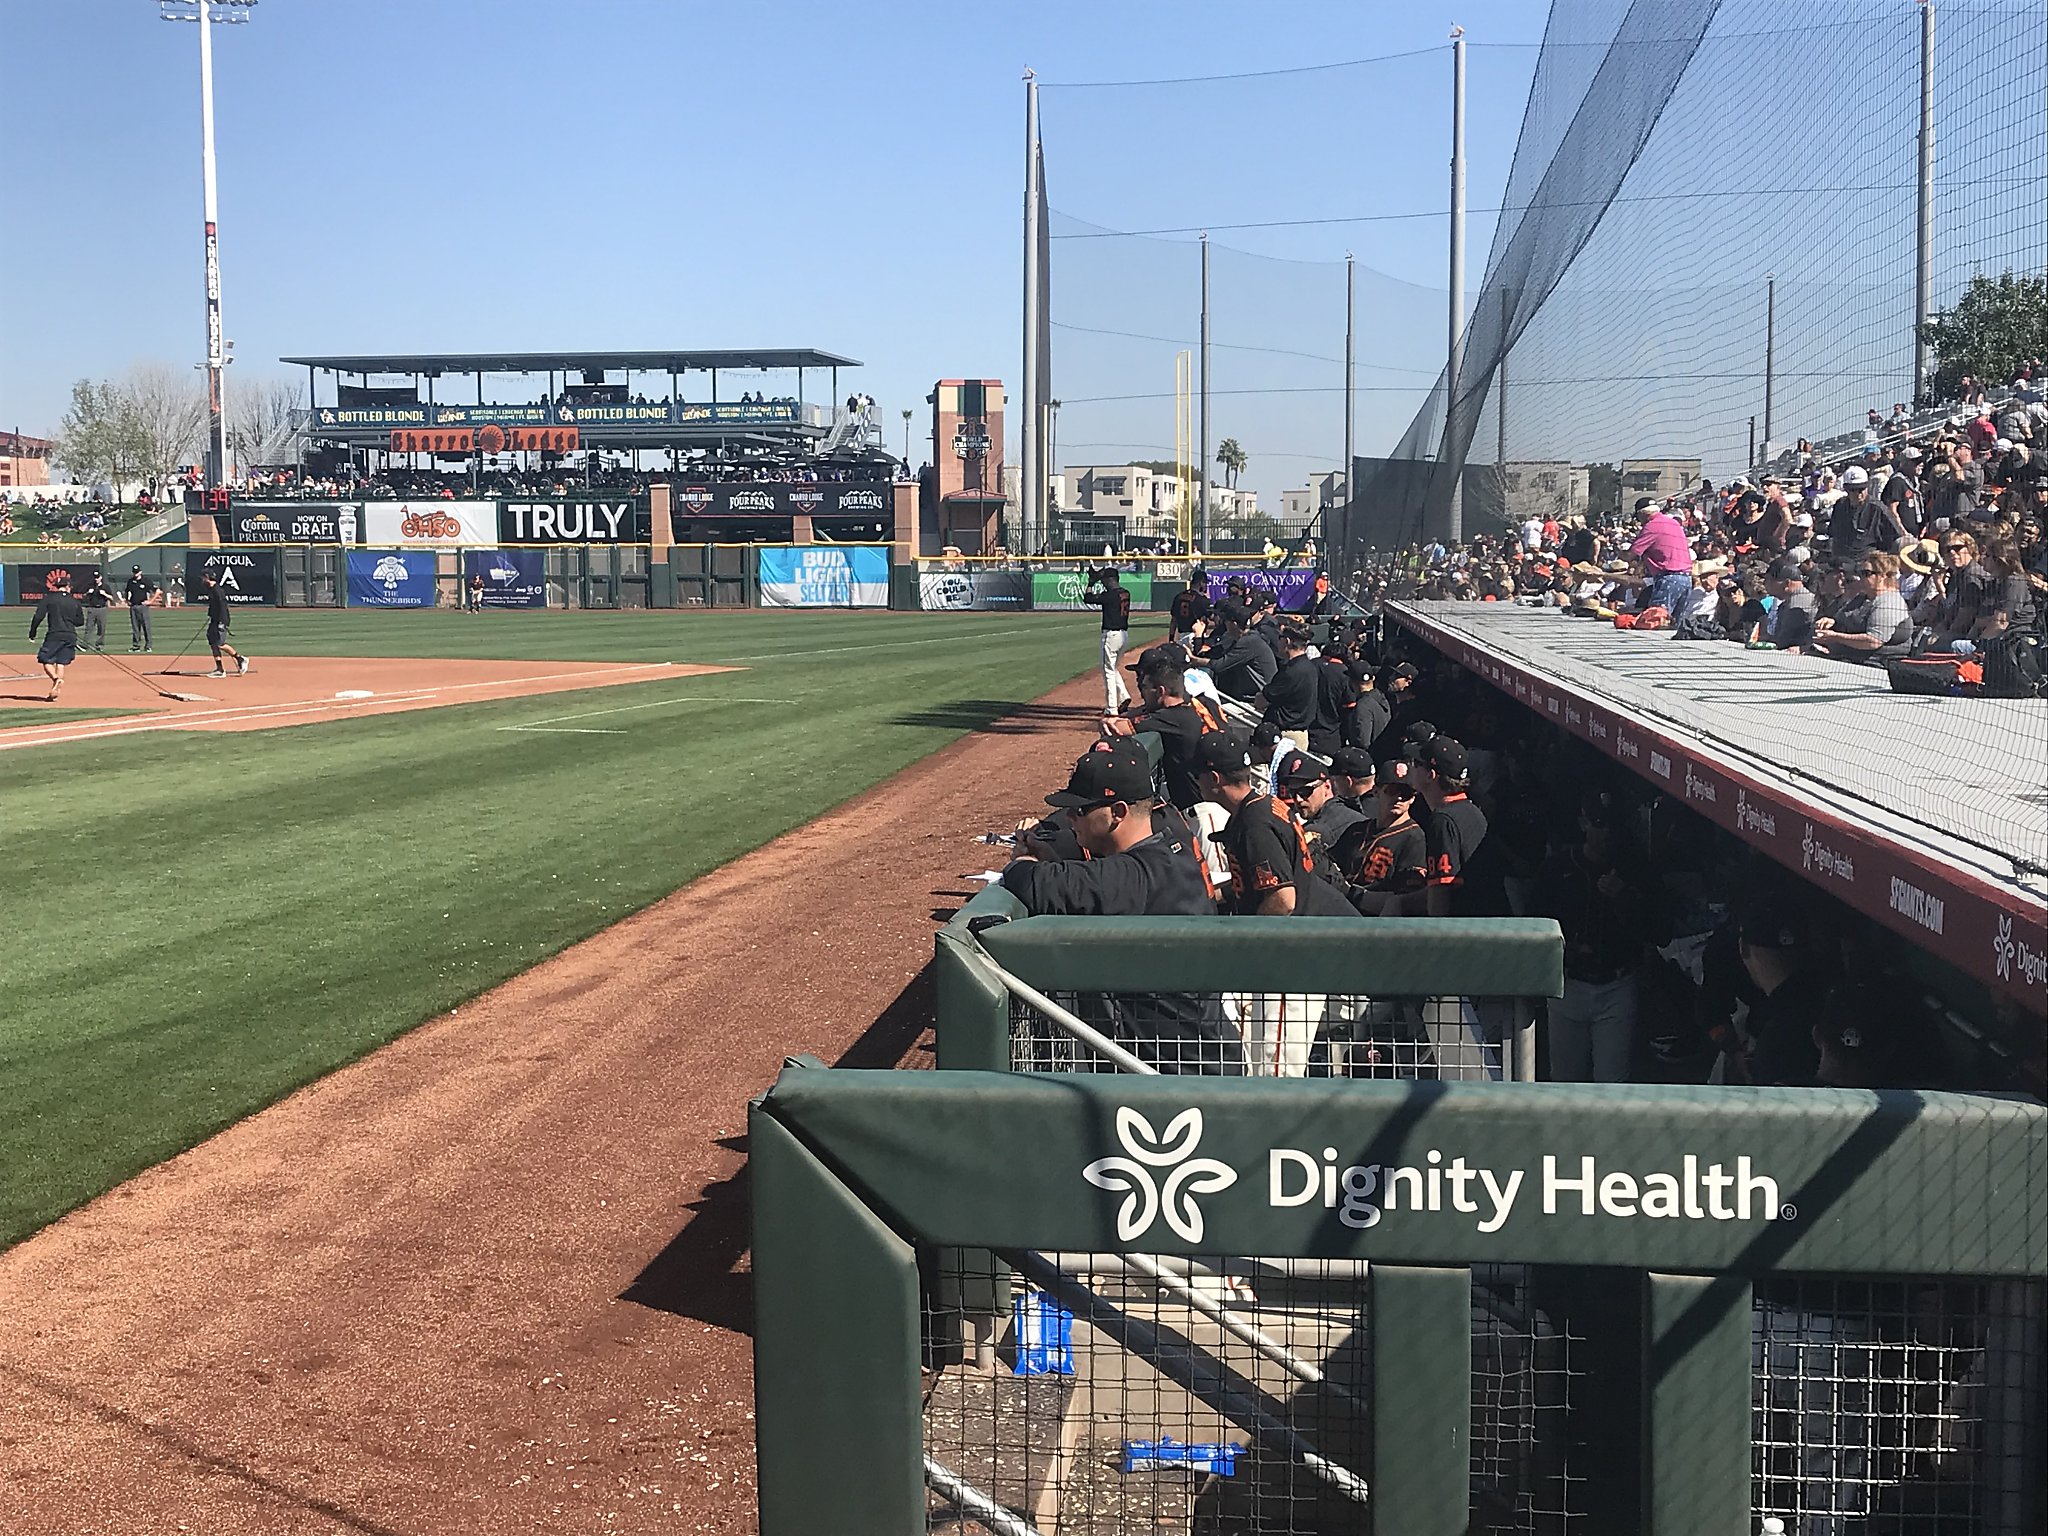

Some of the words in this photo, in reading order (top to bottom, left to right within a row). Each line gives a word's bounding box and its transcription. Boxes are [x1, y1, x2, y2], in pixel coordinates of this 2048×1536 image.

[338, 410, 383, 423] BOTTLED
[385, 410, 425, 422] BLONDE
[577, 408, 625, 420] BOTTLED
[626, 407, 668, 419] BLONDE
[729, 496, 750, 510] FOUR
[750, 496, 775, 510] PEAKS
[838, 496, 859, 510] FOUR
[859, 495, 883, 509] PEAKS
[241, 518, 280, 532] Corona
[291, 522, 335, 535] DRAFT
[401, 518, 461, 538] OHSO
[508, 504, 628, 539] TRULY
[239, 532, 286, 542] PREMIER
[204, 555, 256, 567] ANTIGUA
[803, 552, 845, 568] BUD
[794, 567, 853, 583] LIGHT
[1159, 563, 1180, 575] 330
[1250, 573, 1306, 586] CANYON
[800, 583, 850, 603] SELTZER
[936, 586, 969, 595] COULD.
[361, 596, 422, 604] THUNDERBIRDS
[1814, 841, 1834, 876] Dignity
[1834, 851, 1854, 882] Health
[1890, 875, 1944, 936] SFGIANTS.COM
[2017, 941, 2048, 993] Dignit
[1268, 1147, 1525, 1234] Dignity
[1543, 1153, 1778, 1222] Health
